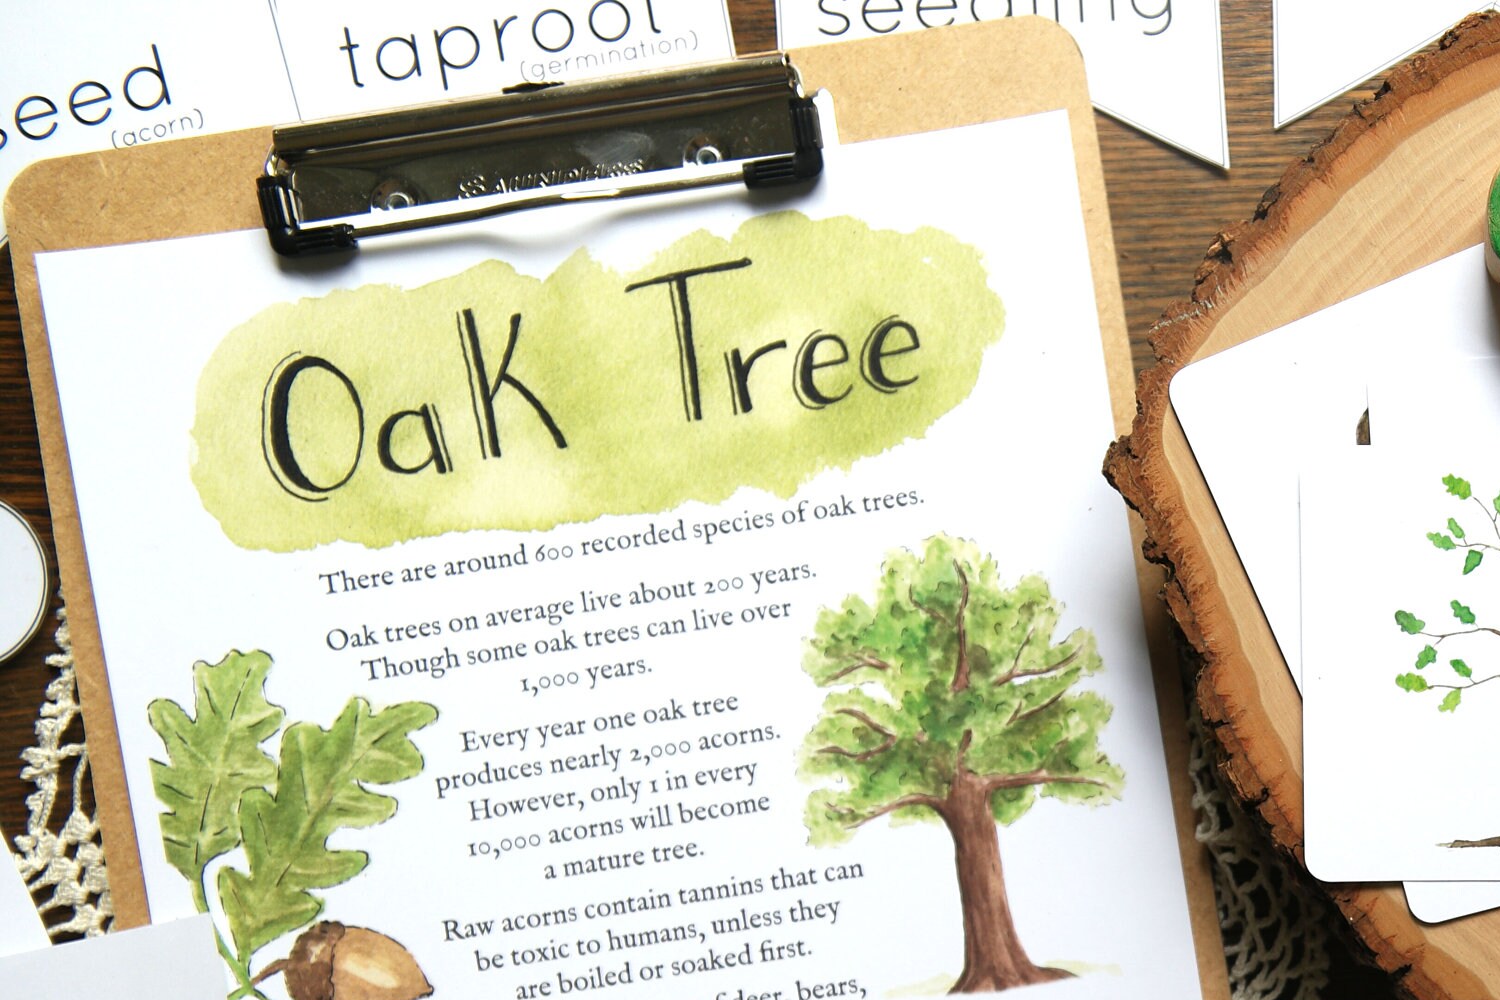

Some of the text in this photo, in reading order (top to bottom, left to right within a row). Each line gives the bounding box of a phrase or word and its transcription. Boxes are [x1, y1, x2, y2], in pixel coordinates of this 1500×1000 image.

[520, 30, 699, 82] (germination)
[111, 108, 204, 149] (acorn)
[624, 257, 920, 421] Tree
[318, 490, 924, 595] There are around 600 recorded species of oak trees.
[325, 564, 817, 652] Oak trees on average live about 200 years.
[360, 603, 792, 681] Though some oak trees can live over
[520, 659, 653, 697] 1,000 years.
[459, 696, 739, 753] Every year one oak tree
[435, 725, 781, 800] produces nearly 2,000 acorns.
[468, 762, 757, 822] However, only 1 in every
[468, 796, 770, 860] 10,000 acorns will become
[544, 842, 705, 880] a mature tree.
[441, 863, 864, 942] Raw acorns contain tannins that can
[473, 899, 841, 972] be toxic to humans, unless they
[515, 939, 812, 1000] are boiled or soaked first.
